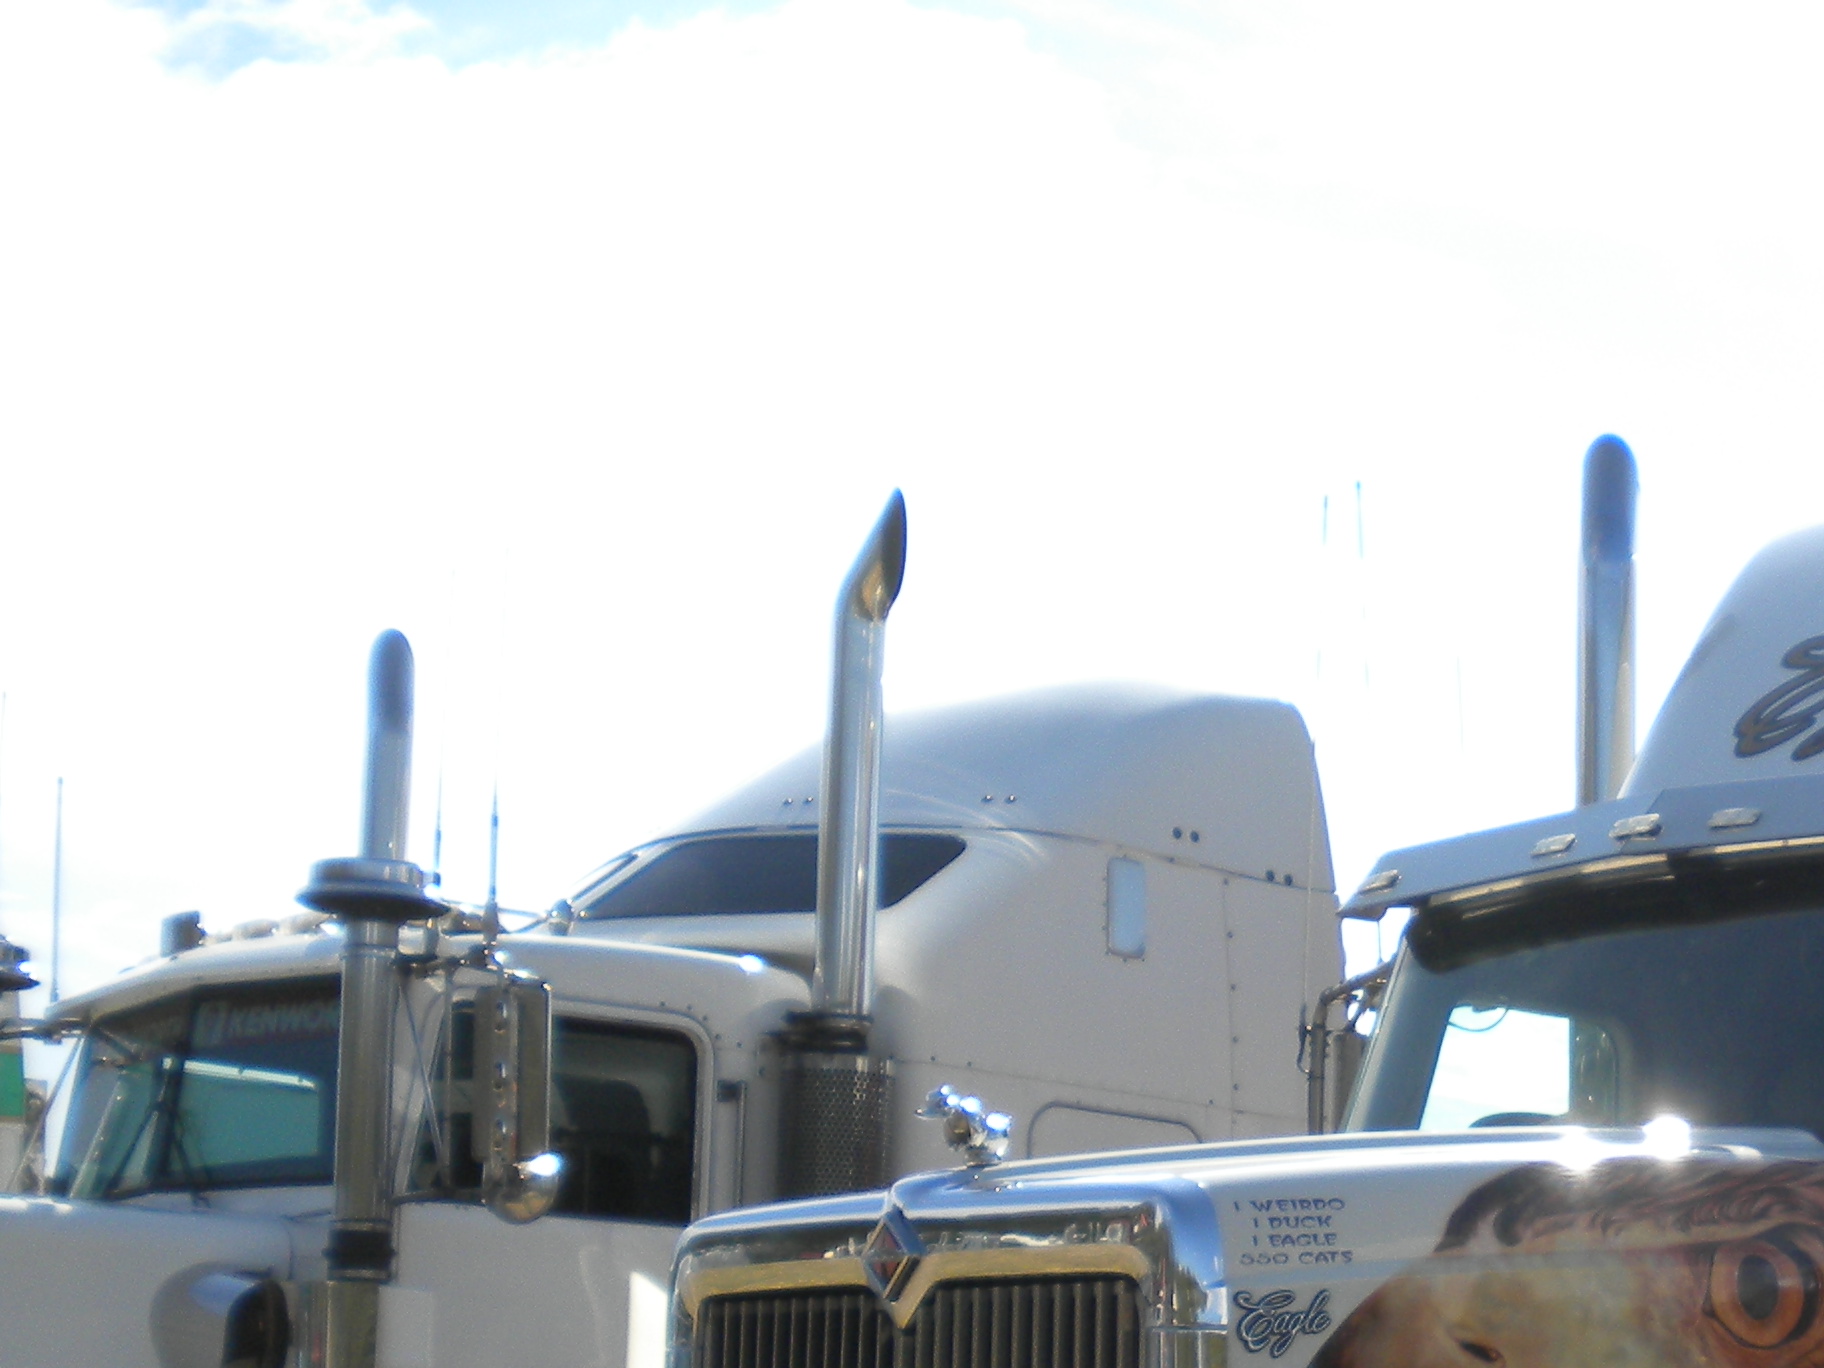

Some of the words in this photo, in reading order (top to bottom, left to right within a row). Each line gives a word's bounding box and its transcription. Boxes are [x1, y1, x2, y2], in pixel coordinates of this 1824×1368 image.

[1250, 1198, 1346, 1213] WEIRDO
[1268, 1215, 1333, 1229] DUCK
[1267, 1233, 1338, 1247] EAGLE
[1298, 1251, 1354, 1265] CATS
[1233, 1288, 1333, 1359] Eagle
